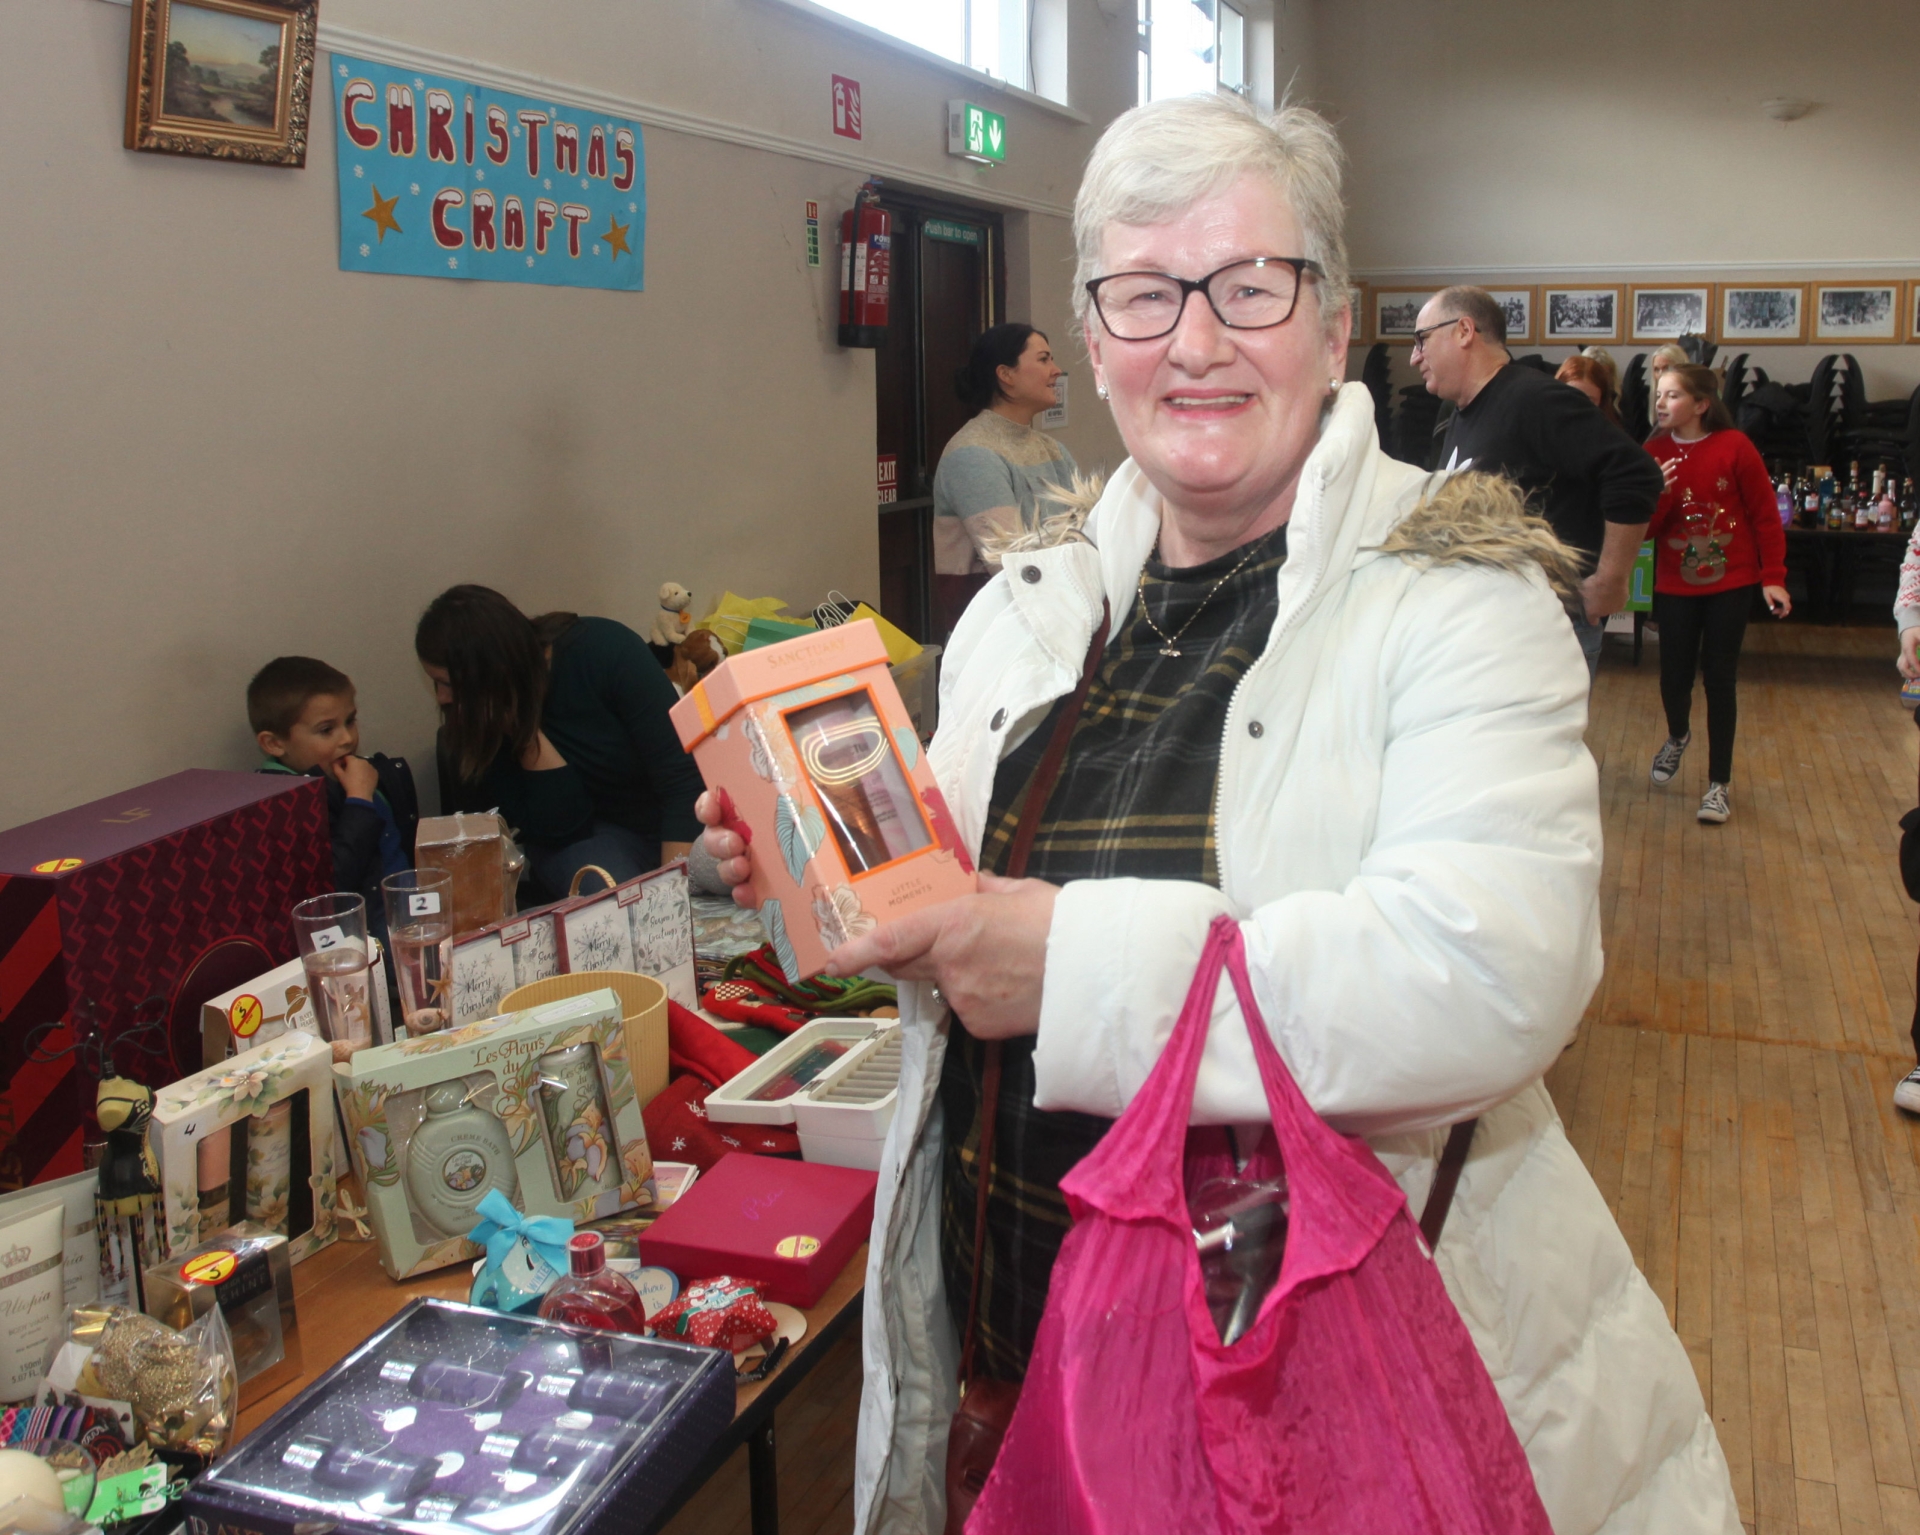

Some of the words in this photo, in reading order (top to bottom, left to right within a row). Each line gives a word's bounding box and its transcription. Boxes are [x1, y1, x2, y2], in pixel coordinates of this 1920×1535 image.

[341, 77, 636, 192] CHRISTMAS
[430, 186, 591, 260] CRAFT
[924, 221, 942, 235] Push
[942, 224, 954, 237] bar
[962, 230, 978, 242] open
[878, 460, 897, 482] EXIT
[415, 896, 429, 911] 2
[888, 883, 933, 908] MOMENTS
[318, 933, 336, 949] 2
[473, 1046, 498, 1068] Les
[498, 1037, 547, 1059] Fleurs
[502, 1061, 520, 1076] du
[184, 1123, 197, 1137] 4
